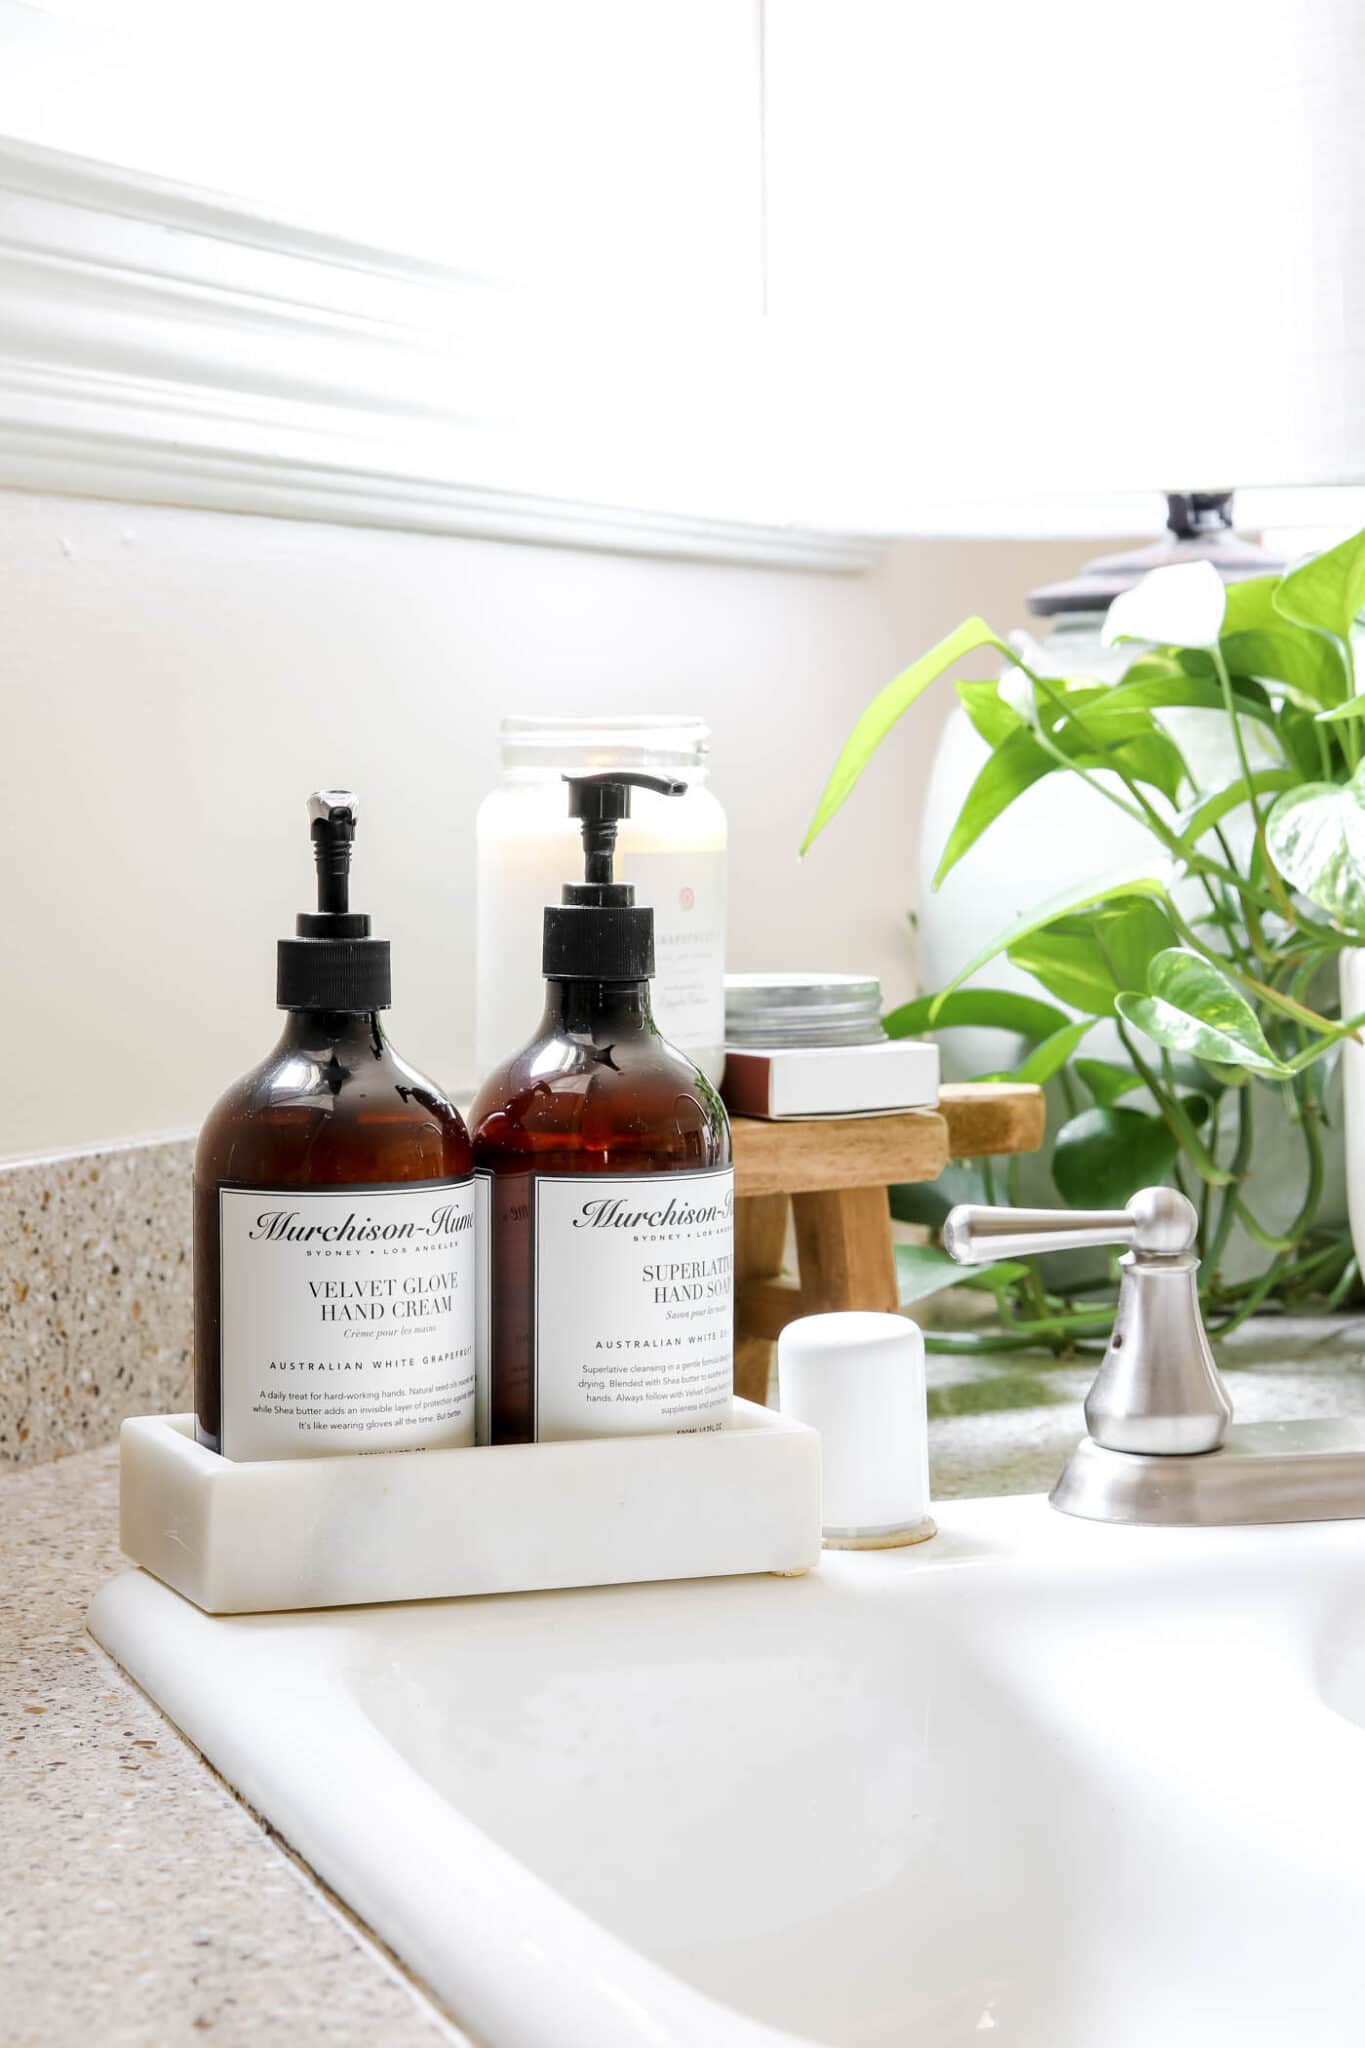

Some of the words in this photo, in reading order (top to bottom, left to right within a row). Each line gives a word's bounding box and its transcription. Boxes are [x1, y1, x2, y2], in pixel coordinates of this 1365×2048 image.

[572, 1189, 733, 1228] Murchison-H
[249, 1204, 474, 1242] Murchison-Hume
[633, 1234, 681, 1242] SYDNEY
[416, 1242, 459, 1252] ANGELES
[309, 1279, 397, 1298] VELVET
[403, 1272, 459, 1294] GLOVE
[653, 1284, 703, 1304] HAND
[321, 1304, 384, 1321] HAND
[392, 1296, 452, 1318] CREAM
[343, 1328, 374, 1339] Crème
[376, 1328, 398, 1340] pour
[401, 1326, 412, 1336] les
[596, 1338, 682, 1349] AUSTRALIAN
[688, 1333, 717, 1344] WHITE
[270, 1361, 363, 1371] AUSTRALIAN
[373, 1358, 415, 1369] WHITE
[423, 1346, 472, 1364] GRAPEFRUIT
[582, 1364, 628, 1374] Superlative
[630, 1364, 665, 1374] cleansing
[610, 1379, 643, 1388] Blended
[645, 1377, 661, 1387] with
[663, 1375, 680, 1386] Shea
[267, 1391, 285, 1402] daily
[288, 1392, 307, 1400] treat
[310, 1391, 321, 1400] for
[324, 1391, 379, 1402] hard-working
[381, 1390, 406, 1398] hands.
[409, 1383, 434, 1396] Natural
[616, 1393, 644, 1404] Always
[646, 1392, 668, 1402] follow
[253, 1406, 272, 1414] while
[275, 1406, 293, 1415] Shea
[296, 1407, 321, 1415] butter
[324, 1406, 344, 1415] adds
[360, 1404, 392, 1413] invisible
[395, 1402, 413, 1414] layer
[415, 1400, 422, 1409] of
[299, 1422, 310, 1430] It's
[313, 1421, 327, 1430] like
[330, 1422, 364, 1432] wearing
[366, 1420, 392, 1432] gloves
[395, 1418, 403, 1426] all
[405, 1417, 417, 1425] the
